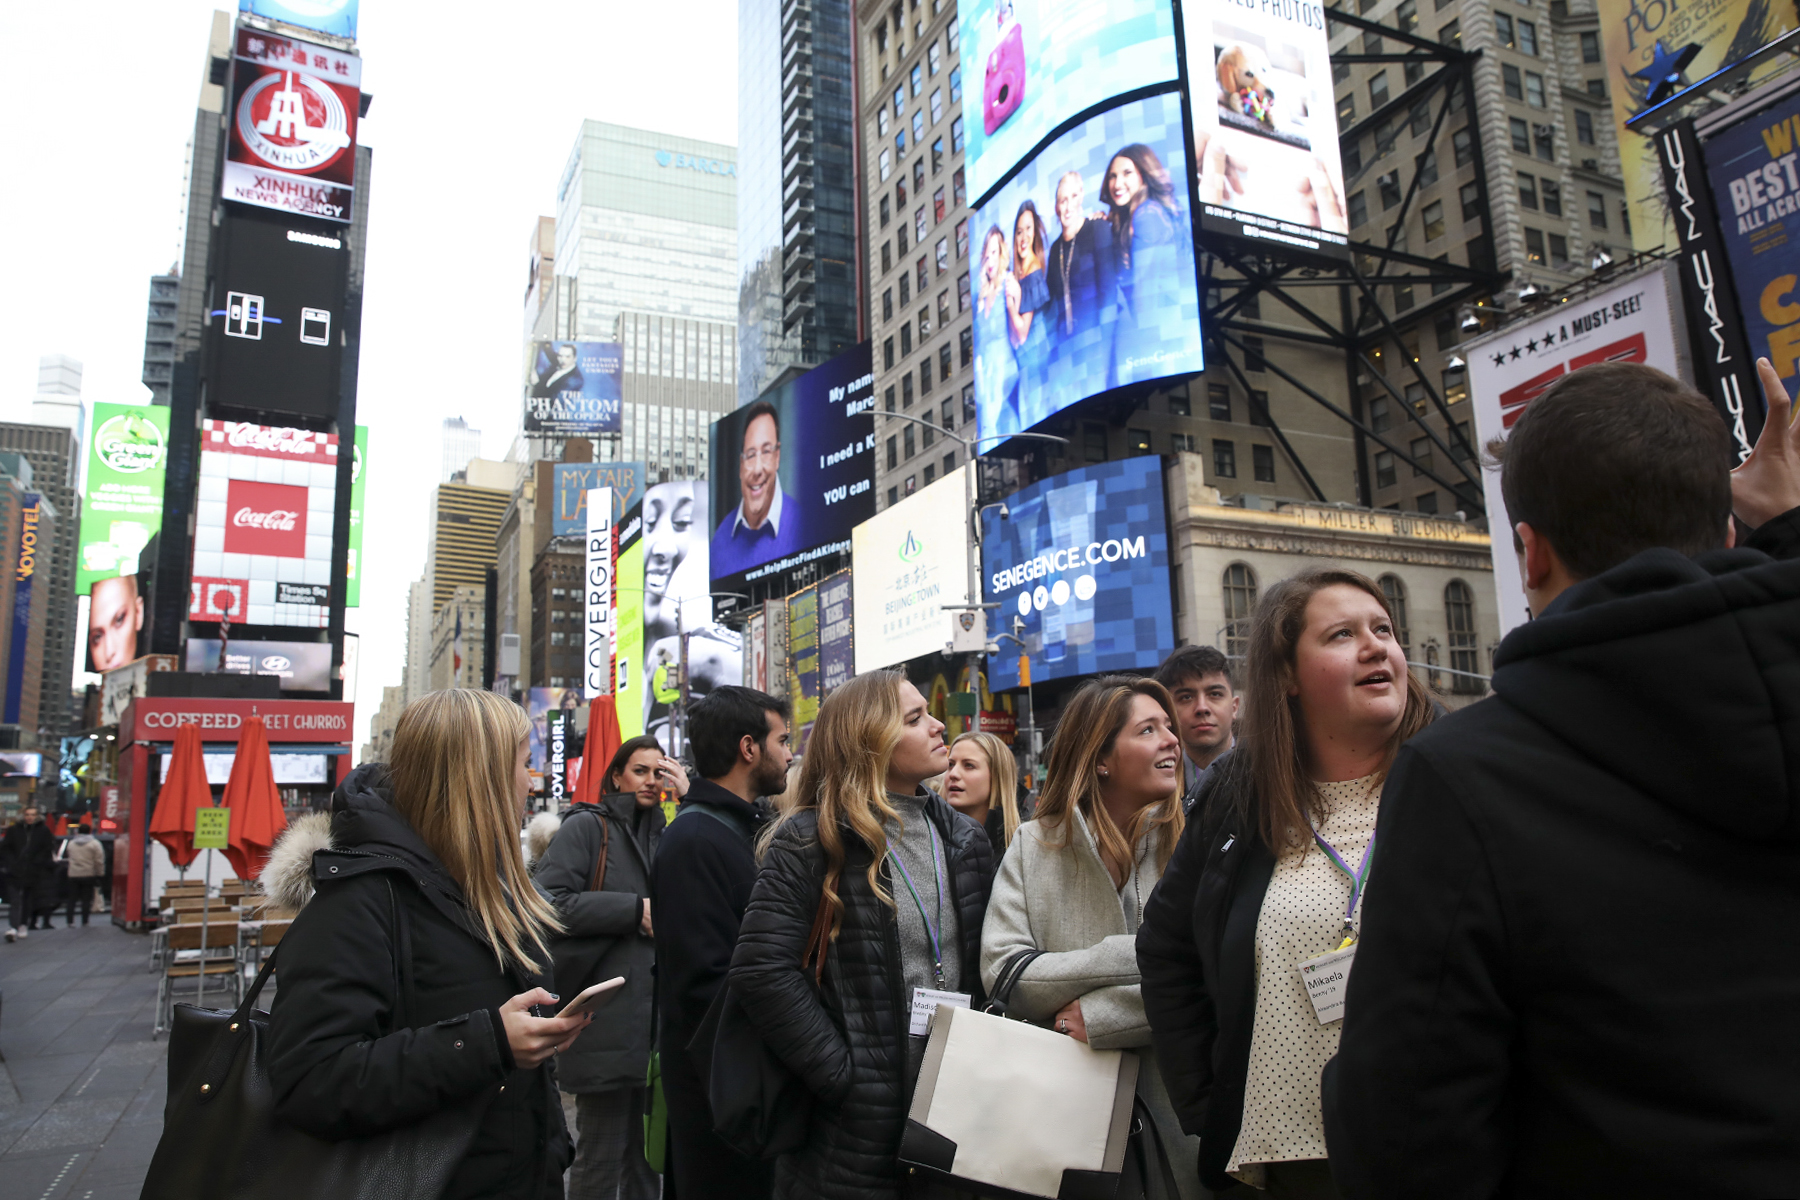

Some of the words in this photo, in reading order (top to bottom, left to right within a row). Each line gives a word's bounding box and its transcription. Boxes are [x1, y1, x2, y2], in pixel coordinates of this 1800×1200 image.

[254, 139, 320, 164] XINHUA
[253, 174, 329, 202] XINHUA
[1729, 152, 1800, 216] BEST
[235, 187, 279, 205] NEWS
[281, 195, 343, 218] AGENCY
[1738, 210, 1766, 236] ALL
[1559, 325, 1570, 342] A
[526, 397, 619, 413] PHANTOM
[561, 390, 584, 399] THE
[828, 386, 846, 404] My
[846, 394, 875, 418] Marc
[533, 411, 550, 420] OF
[552, 411, 574, 420] THE
[574, 412, 611, 422] OPERA
[820, 455, 825, 470] I
[827, 446, 853, 466] need
[856, 441, 864, 454] a
[562, 469, 592, 489] MY
[597, 468, 636, 489] FAIR
[561, 487, 636, 520] LAY
[823, 484, 847, 506] YOU
[849, 479, 870, 496] can
[1318, 511, 1378, 531] MILLER
[1392, 519, 1460, 539] BUILDING
[16, 502, 40, 581] NOVOTEL
[992, 535, 1146, 594] SENEGENCE.COM
[279, 584, 310, 595] Times
[313, 587, 327, 598] Sq
[279, 593, 316, 604] Station
[588, 518, 608, 690] COVERGIRL
[144, 712, 242, 729] COFFEED
[293, 714, 347, 730] CHURROS
[968, 716, 1015, 726] Donald's
[1307, 971, 1344, 990] Mikaela
